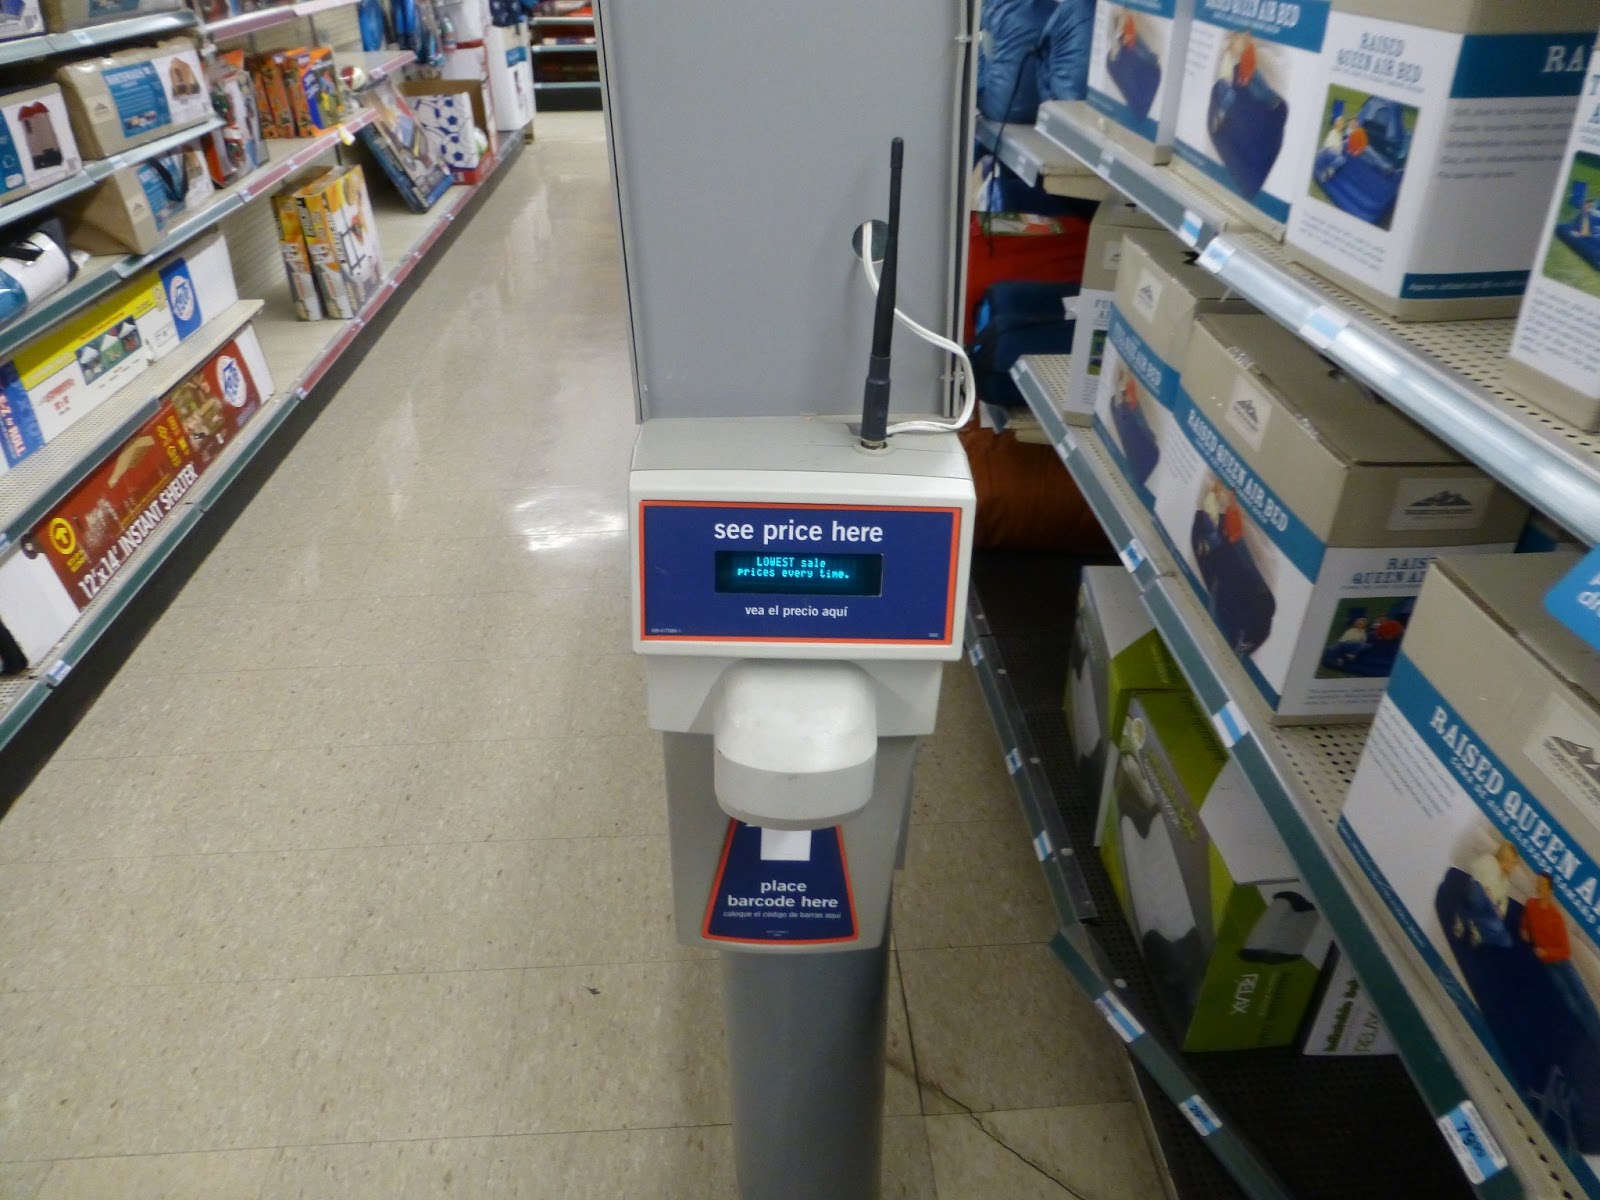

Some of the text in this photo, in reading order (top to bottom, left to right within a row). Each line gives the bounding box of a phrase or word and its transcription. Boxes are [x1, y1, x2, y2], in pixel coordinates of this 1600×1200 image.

[1541, 45, 1586, 72] RA
[117, 500, 165, 558] INSTANT
[158, 463, 199, 511] SHELTER
[1263, 498, 1289, 532] BED
[714, 519, 884, 545] see price here
[756, 556, 826, 568] LOWEST sale
[1386, 556, 1434, 570] RAIS
[737, 567, 850, 579] prices every time.
[745, 605, 849, 619] vea el precio aquí
[1430, 705, 1505, 795] RAISED
[1503, 790, 1582, 881] QUEEN
[760, 879, 807, 894] place
[727, 894, 839, 908] barcode here
[800, 911, 824, 919] barras
